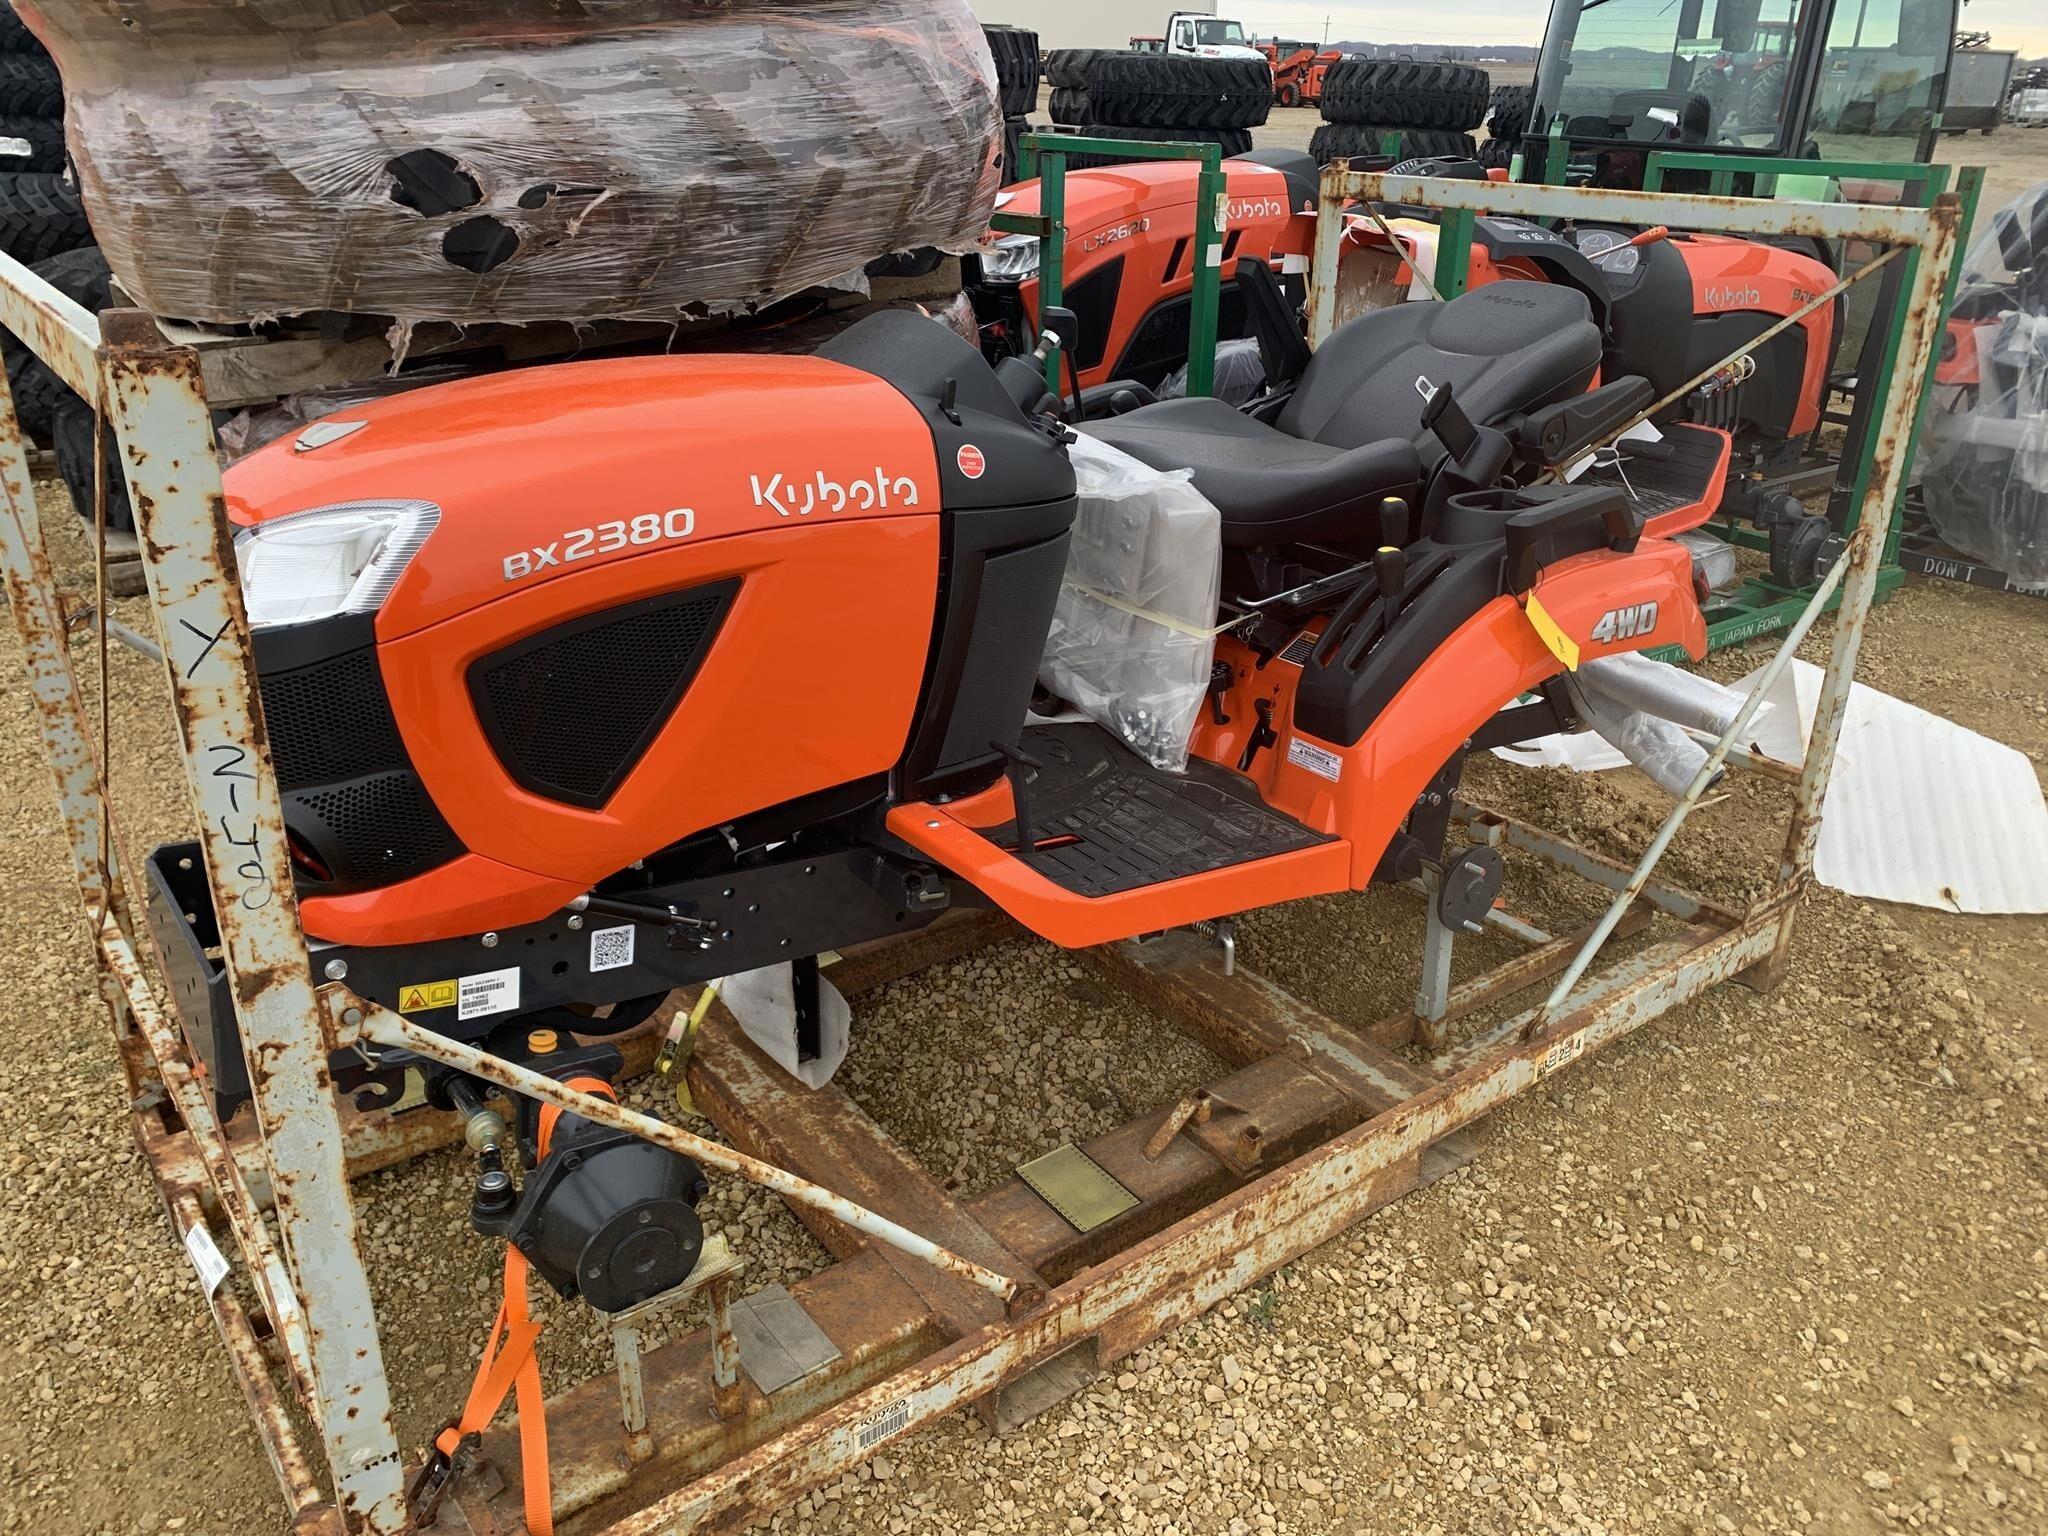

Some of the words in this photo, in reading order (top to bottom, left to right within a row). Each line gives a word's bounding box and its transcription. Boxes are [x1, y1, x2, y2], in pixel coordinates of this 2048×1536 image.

[1224, 197, 1281, 220] Kubota
[1084, 218, 1150, 253] LX2620
[1705, 284, 1761, 309] Kubota
[750, 466, 919, 517] Kubota
[502, 508, 695, 582] BX2380
[1923, 557, 1976, 582] DON'T
[1590, 600, 1659, 645] 4WD
[1721, 624, 1754, 645] JAPAN
[1757, 614, 1783, 636] FORK
[1304, 749, 1326, 763] WARNING
